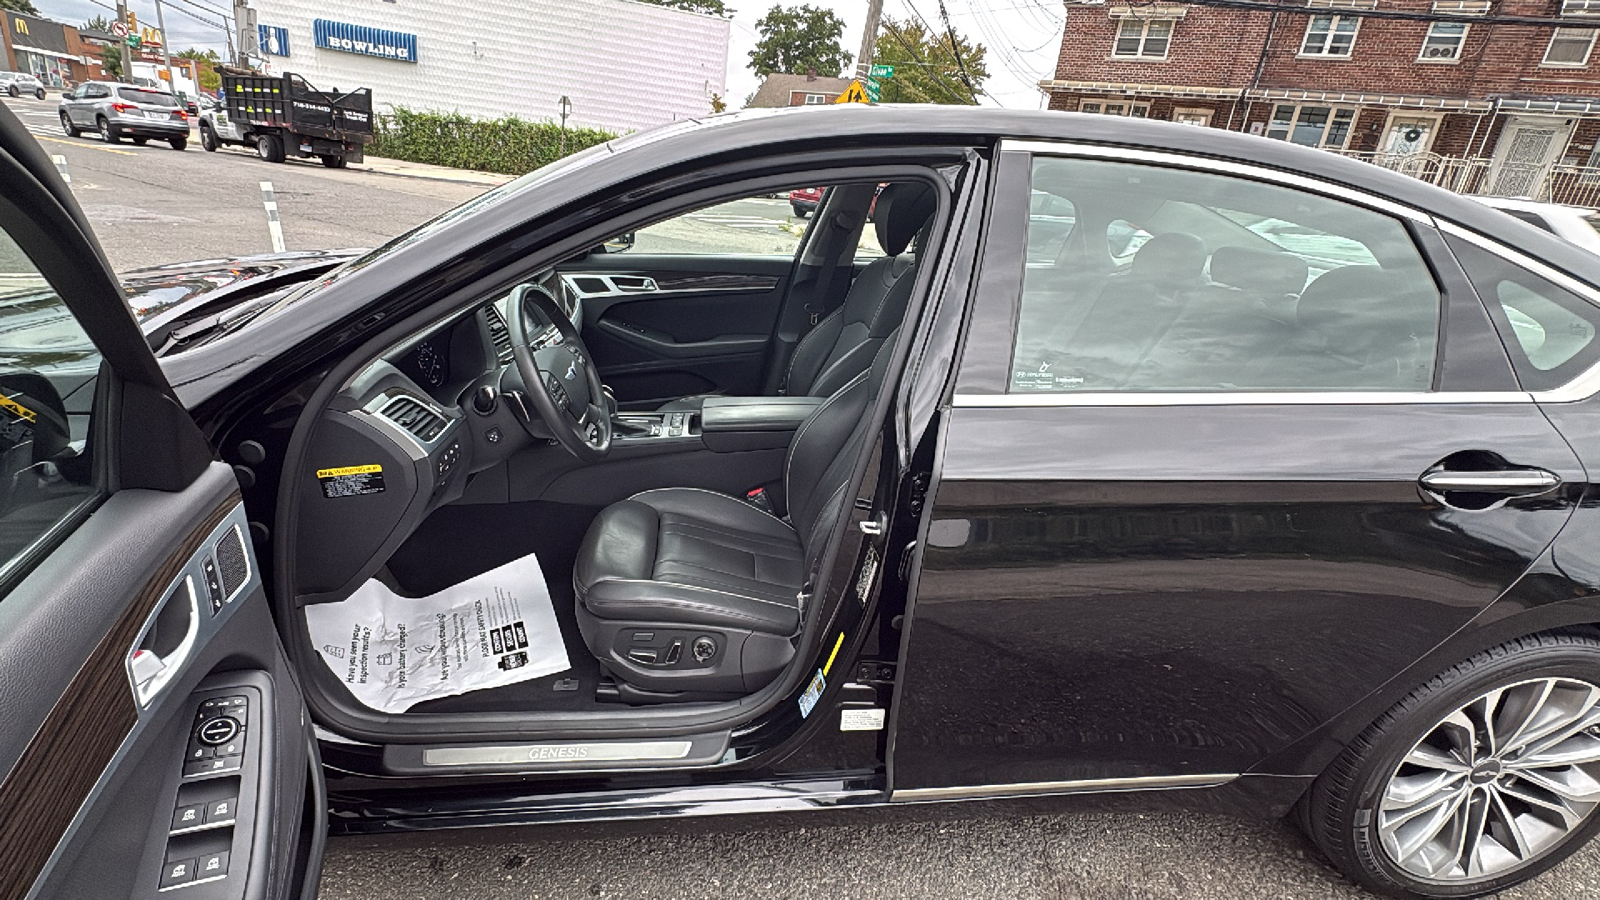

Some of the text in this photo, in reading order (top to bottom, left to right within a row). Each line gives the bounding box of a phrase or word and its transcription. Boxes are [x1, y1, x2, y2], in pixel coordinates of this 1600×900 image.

[328, 36, 408, 57] BOWLING
[352, 624, 361, 641] your
[397, 623, 408, 648] charged?
[475, 599, 490, 658] FLOOR MAT SAFETY CHECK
[349, 656, 358, 667] you
[357, 626, 372, 683] inspection results?
[397, 649, 408, 670] battery
[345, 667, 356, 684] Have
[440, 669, 449, 680] Are
[528, 746, 588, 760] GENESIS
